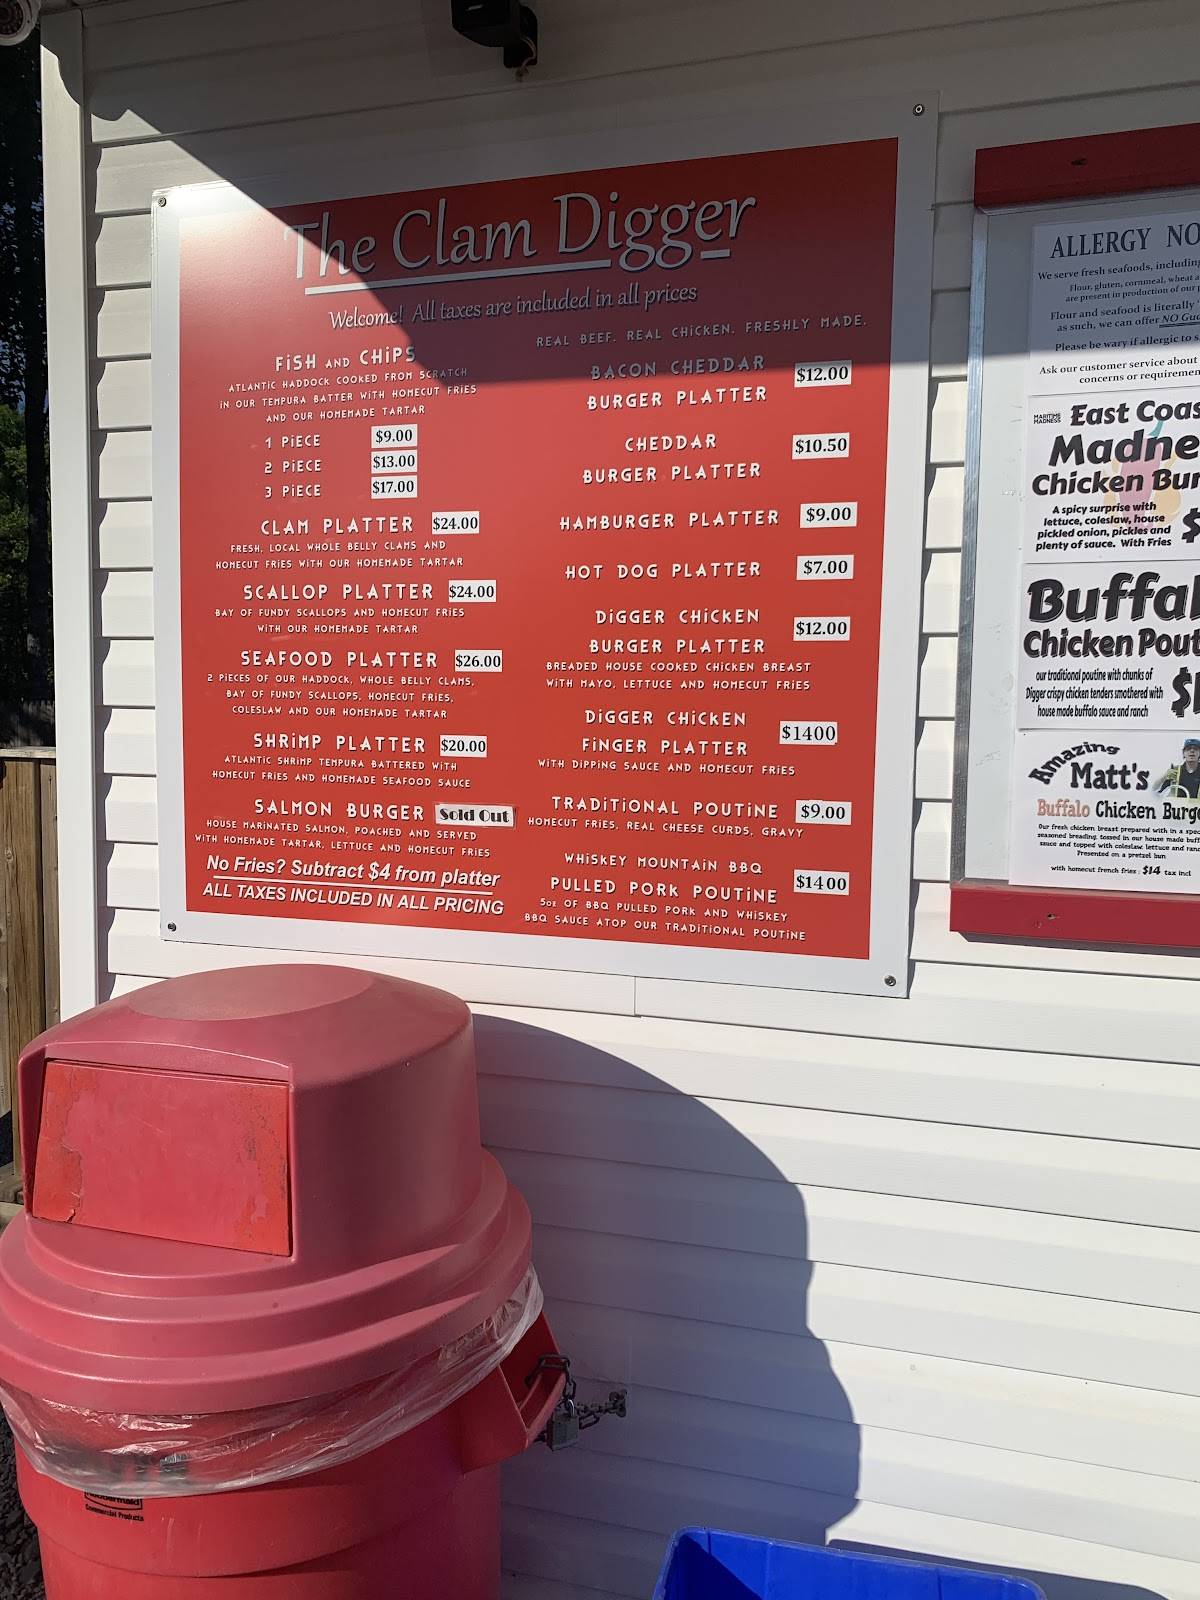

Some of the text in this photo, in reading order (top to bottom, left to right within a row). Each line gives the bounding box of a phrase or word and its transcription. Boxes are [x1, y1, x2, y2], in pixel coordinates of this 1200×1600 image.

[284, 191, 756, 279] The Clam Digger
[1050, 228, 1151, 258] ALLERGY
[329, 282, 698, 329] Welcome! All taxes are included in all prices
[536, 335, 569, 348] REAL
[580, 332, 616, 344] BEEF.
[627, 329, 661, 341] REAL
[746, 318, 809, 333] FRESHLY
[821, 314, 866, 328] MADE.
[325, 357, 350, 368] AND
[591, 356, 765, 380] BACON CHEDDAR
[1040, 366, 1057, 374] Ask
[1080, 363, 1126, 372] customer
[1130, 359, 1165, 369] service
[1168, 356, 1197, 365] about
[282, 377, 329, 389] HADDOCK
[336, 374, 377, 384] COOKED
[385, 370, 412, 381] FROM
[419, 367, 468, 380] SCRATCH
[796, 366, 849, 382] $12.00
[588, 386, 768, 410] BURGER PLATTER
[1070, 403, 1130, 426] East
[265, 437, 271, 449] 1
[375, 429, 413, 443] $9.00
[625, 434, 848, 454] CHEDDAR $10.50
[1048, 429, 1200, 467] Madne
[265, 461, 272, 474] 2
[373, 454, 415, 469] $13.00
[583, 462, 761, 484] BURGER PLATTER
[265, 487, 272, 498] 3
[372, 480, 415, 495] $17.00
[1032, 471, 1144, 496] Chicken
[560, 507, 851, 530] HAMBURGER PLATTER $9.00
[1053, 502, 1156, 515] A spicy surprise with
[261, 516, 478, 535] CLAM PLATTER $24.00
[565, 560, 848, 579] HOT DOG PLATTER $7.00
[243, 584, 494, 600] SCALLOP PLATTER $24.00
[215, 609, 236, 617] BAY
[240, 609, 252, 617] OF
[259, 609, 290, 617] FUNDY
[297, 608, 347, 617] SCALLOPS
[354, 609, 374, 617] AND
[382, 609, 429, 617] HOMECUT
[796, 622, 847, 636] $12.00
[589, 639, 765, 653] BURGER PLATTER
[1023, 628, 1134, 658] Chicken
[241, 651, 501, 668] SEAFOOD PLATTER $26.00
[546, 662, 598, 671] BREADED
[606, 662, 642, 671] HOUSE
[650, 662, 697, 671] COOKED
[763, 663, 811, 672] BREAST
[1036, 668, 1153, 682] our traditional poutine with chunks of
[337, 736, 426, 752] PLATTER
[441, 740, 486, 753] $20.00
[661, 741, 748, 756] PLATTER
[1028, 742, 1150, 790] Amazing Matt's
[255, 799, 510, 823] SALMON BURGER Sold Out
[801, 803, 846, 820] $9.00
[1037, 799, 1090, 818] Buffalo
[1096, 801, 1156, 819] Chicken
[207, 855, 500, 888] No Fries? Subtract $4 from platter
[729, 861, 762, 875] BBQ
[1143, 866, 1161, 875] $14
[551, 877, 616, 893] PULLED
[629, 881, 679, 897] PORK
[203, 883, 505, 915] ALL TAXES INCLUDED IN ALL PRICING
[85, 1504, 144, 1521] Commercial Products
